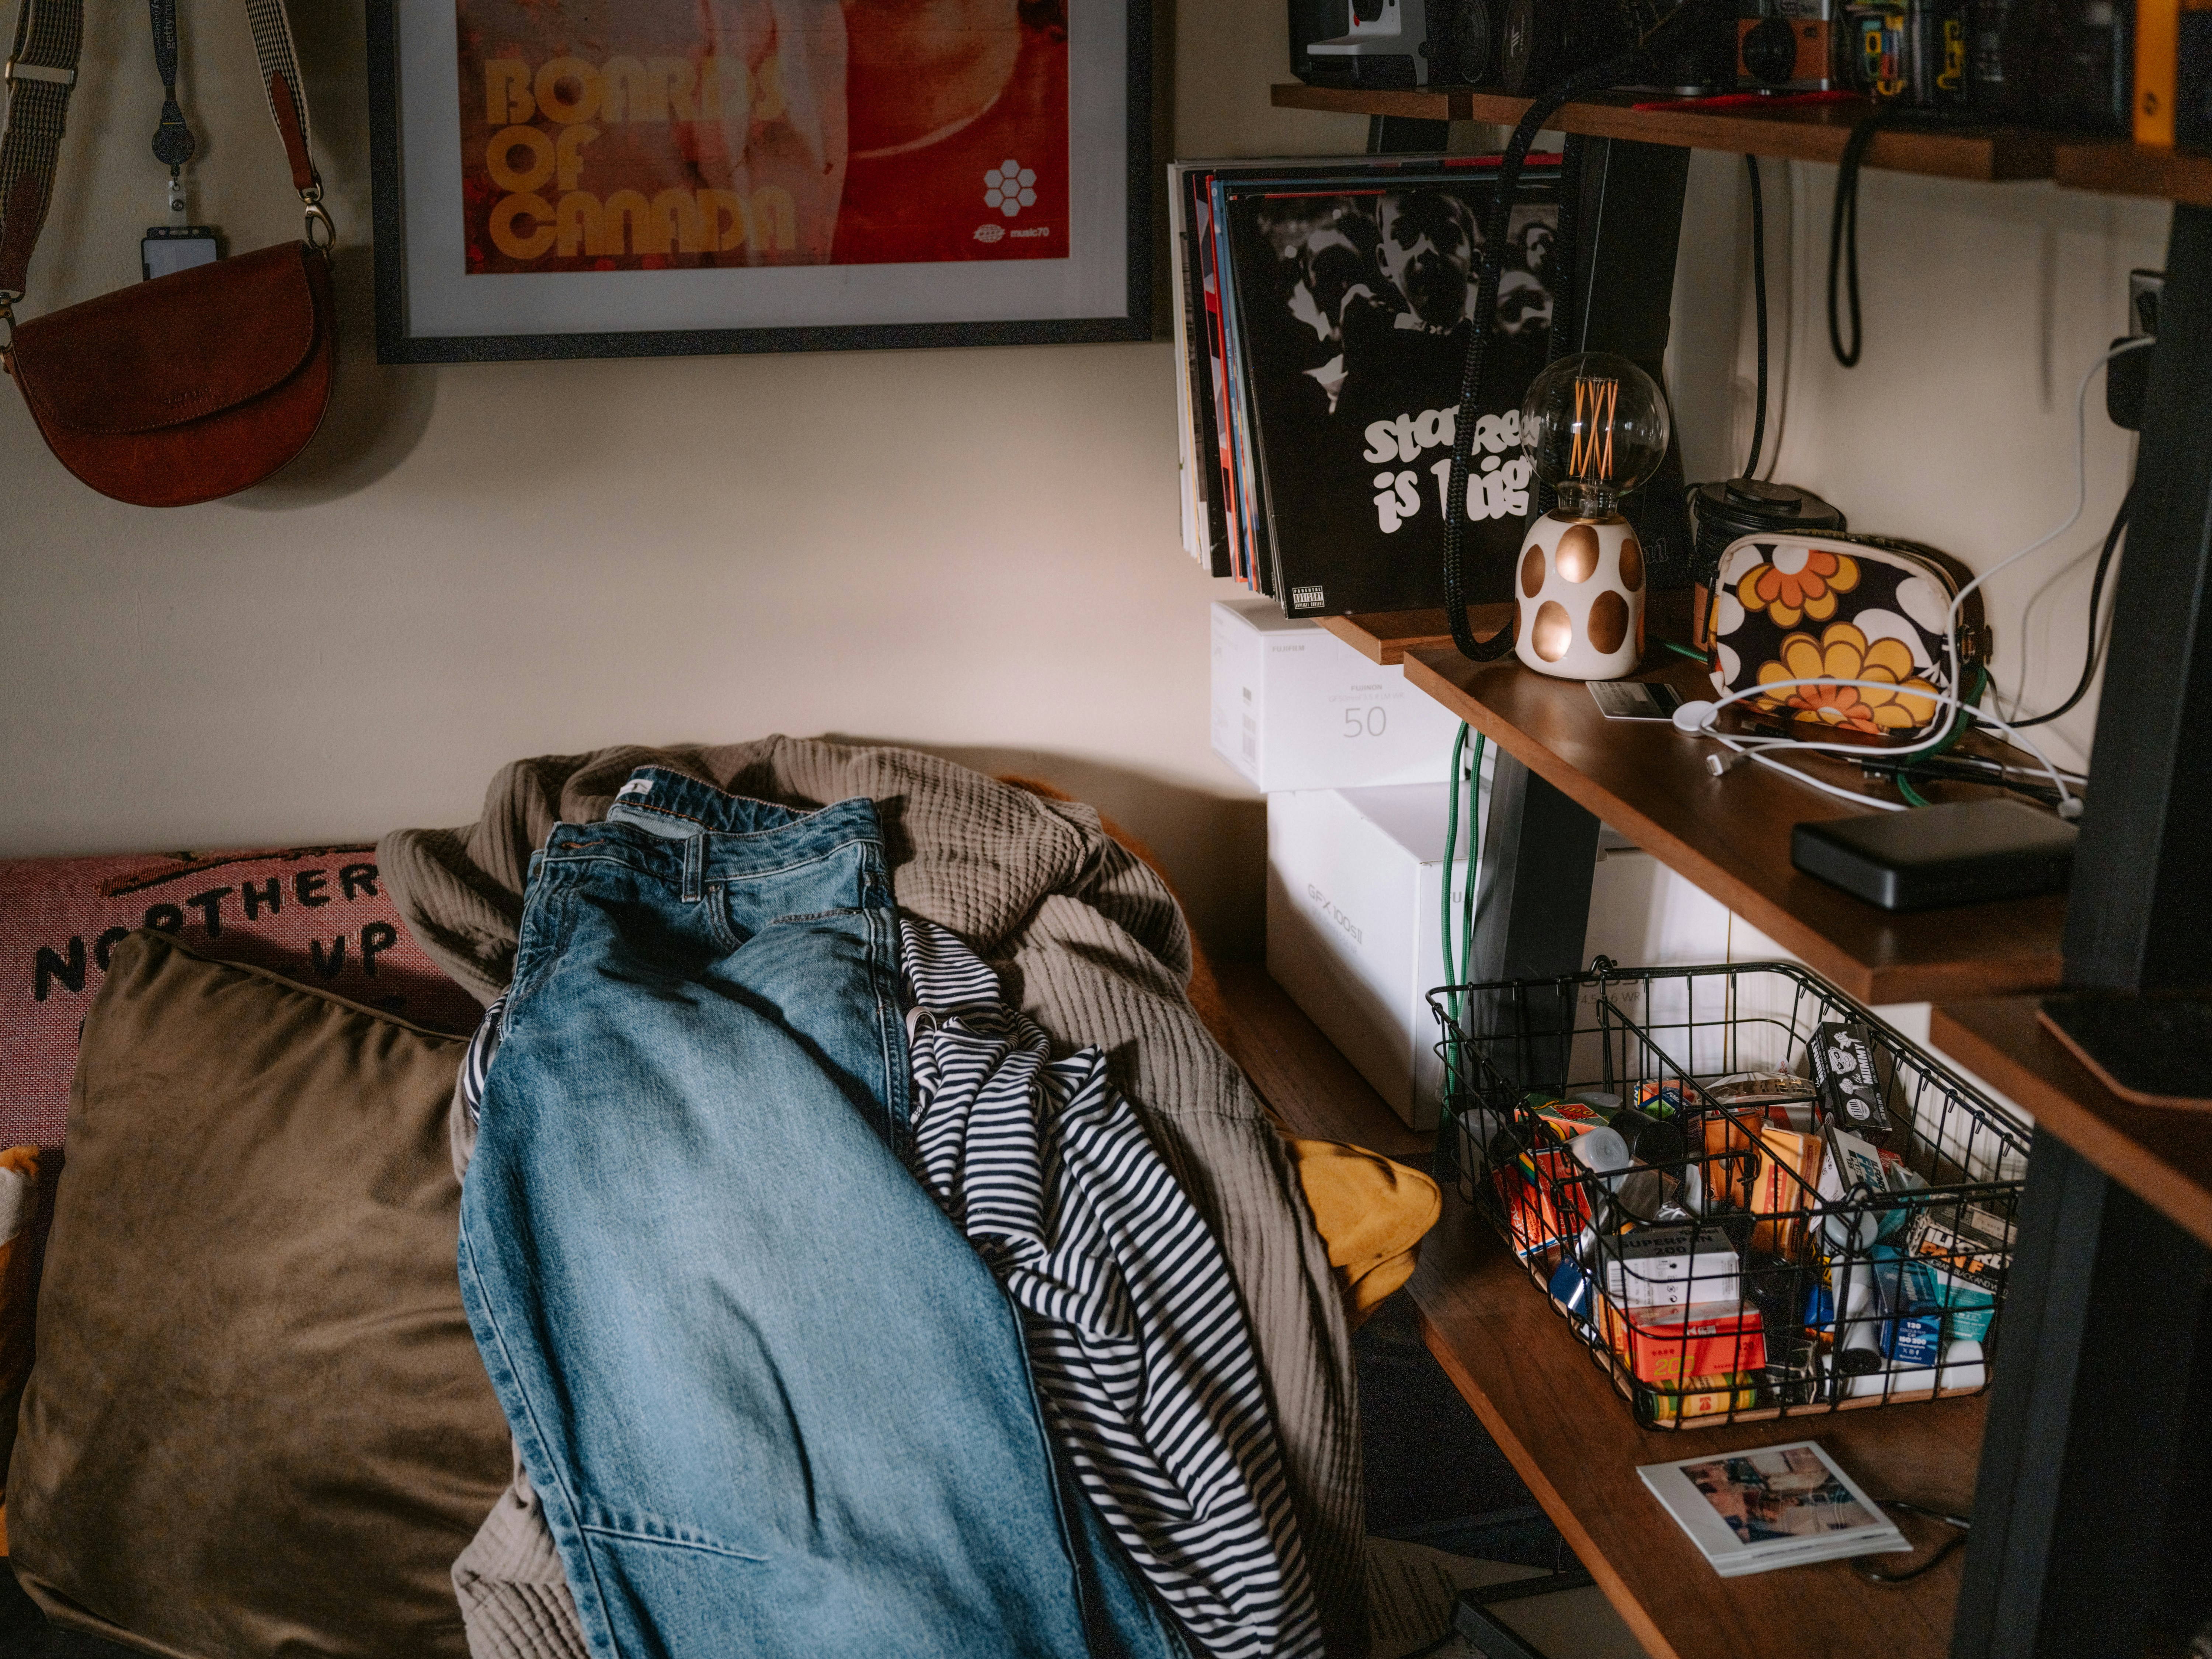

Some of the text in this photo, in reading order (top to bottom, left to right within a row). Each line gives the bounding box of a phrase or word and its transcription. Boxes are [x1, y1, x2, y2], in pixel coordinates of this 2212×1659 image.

[485, 55, 786, 125] BOARDS
[489, 186, 796, 260] CANADA
[1010, 226, 1050, 238] music70
[1373, 470, 1420, 534] is
[1295, 592, 1322, 602] ADVISORY
[1344, 706, 1386, 737] 50
[311, 921, 397, 979] UP
[1622, 992, 1640, 1002] WR
[1811, 1039, 1825, 1085] MUMMY
[1854, 1043, 1874, 1085] MUMMY
[1852, 1073, 1862, 1084] the
[1533, 1100, 1595, 1116] foma
[1850, 1156, 1862, 1177] PLUS
[1856, 1152, 1880, 1189] FP4
[1870, 1159, 1886, 1193] ILFORD
[1655, 1246, 1687, 1255] 200
[1968, 1259, 1984, 1274] F
[1954, 1268, 1973, 1281] BLACK
[1974, 1276, 1992, 1287] AND
[1912, 1337, 1927, 1345] 200
[1653, 1355, 1695, 1377] 200
